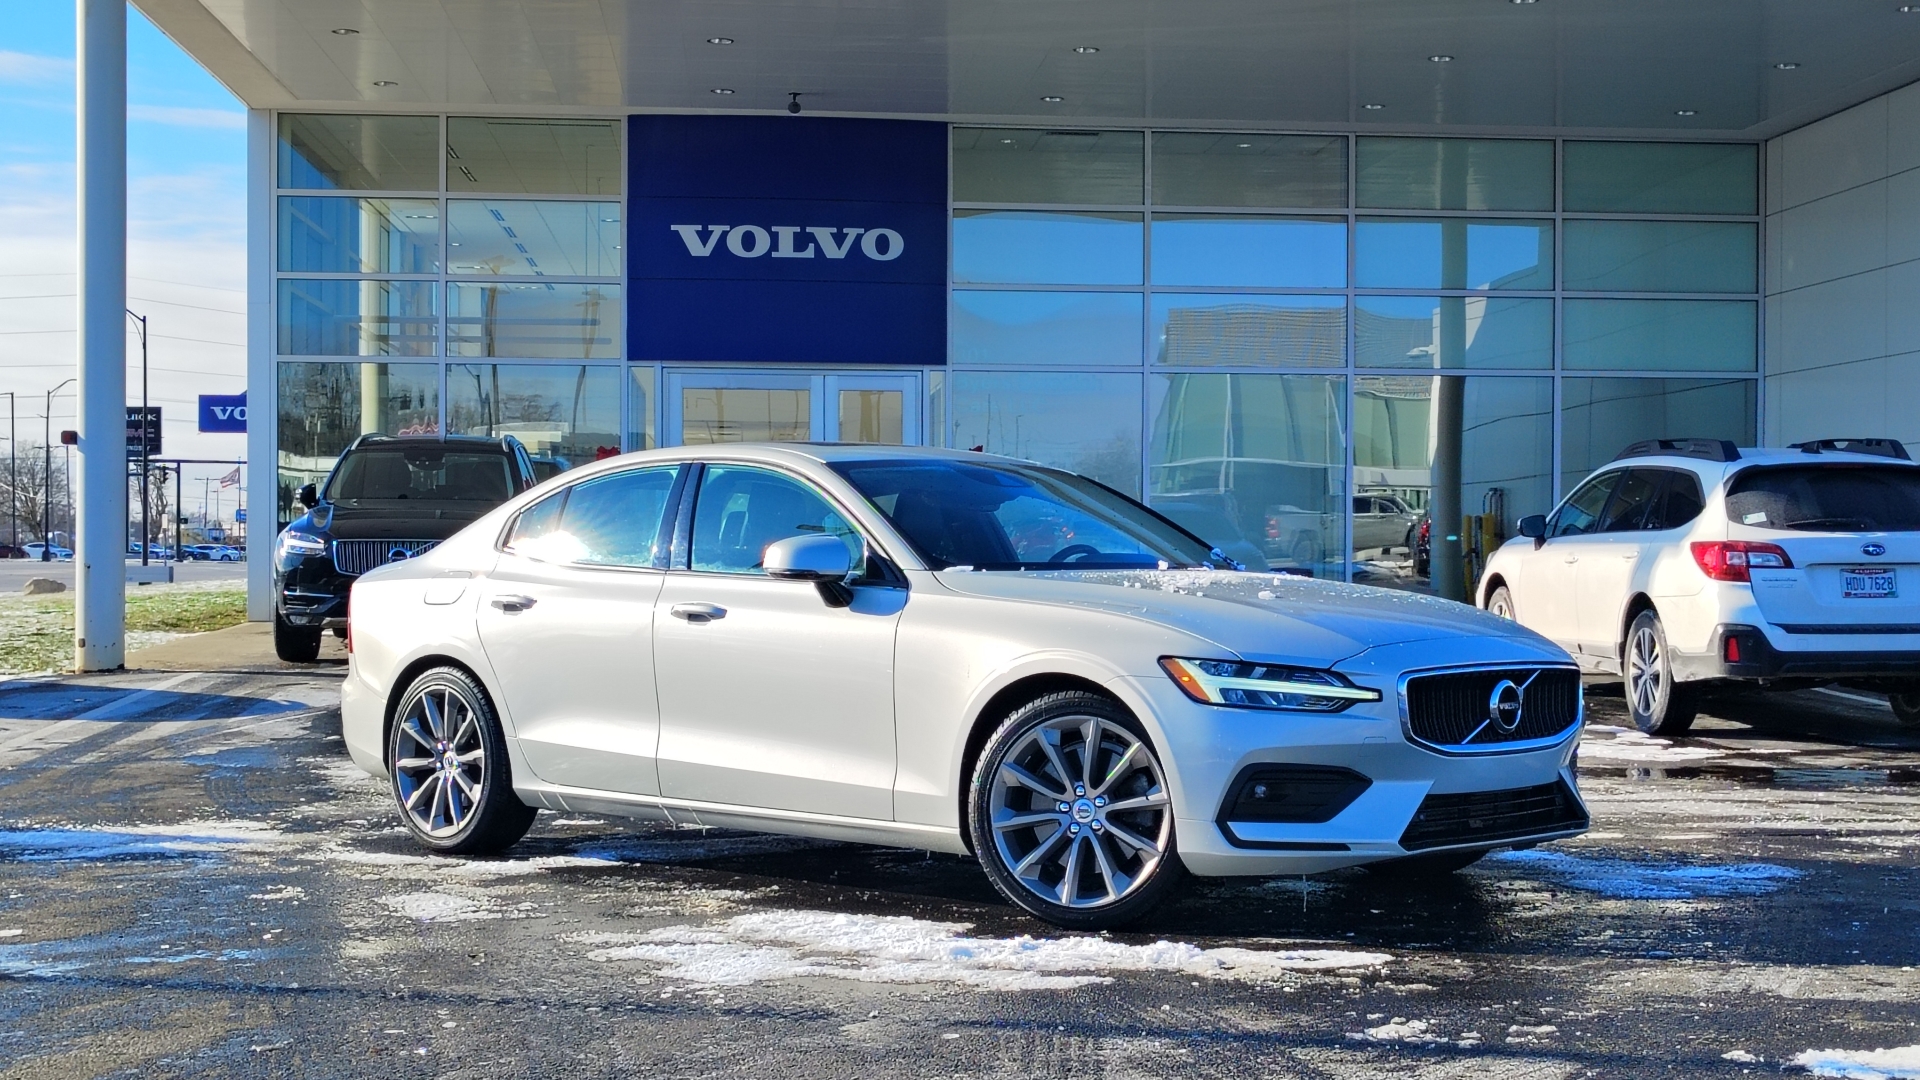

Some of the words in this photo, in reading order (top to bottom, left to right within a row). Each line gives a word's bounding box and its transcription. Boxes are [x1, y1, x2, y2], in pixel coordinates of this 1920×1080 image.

[671, 225, 904, 260] VOLVO
[210, 406, 247, 420] VO
[1845, 577, 1866, 591] HDU
[1867, 577, 1894, 591] 7628
